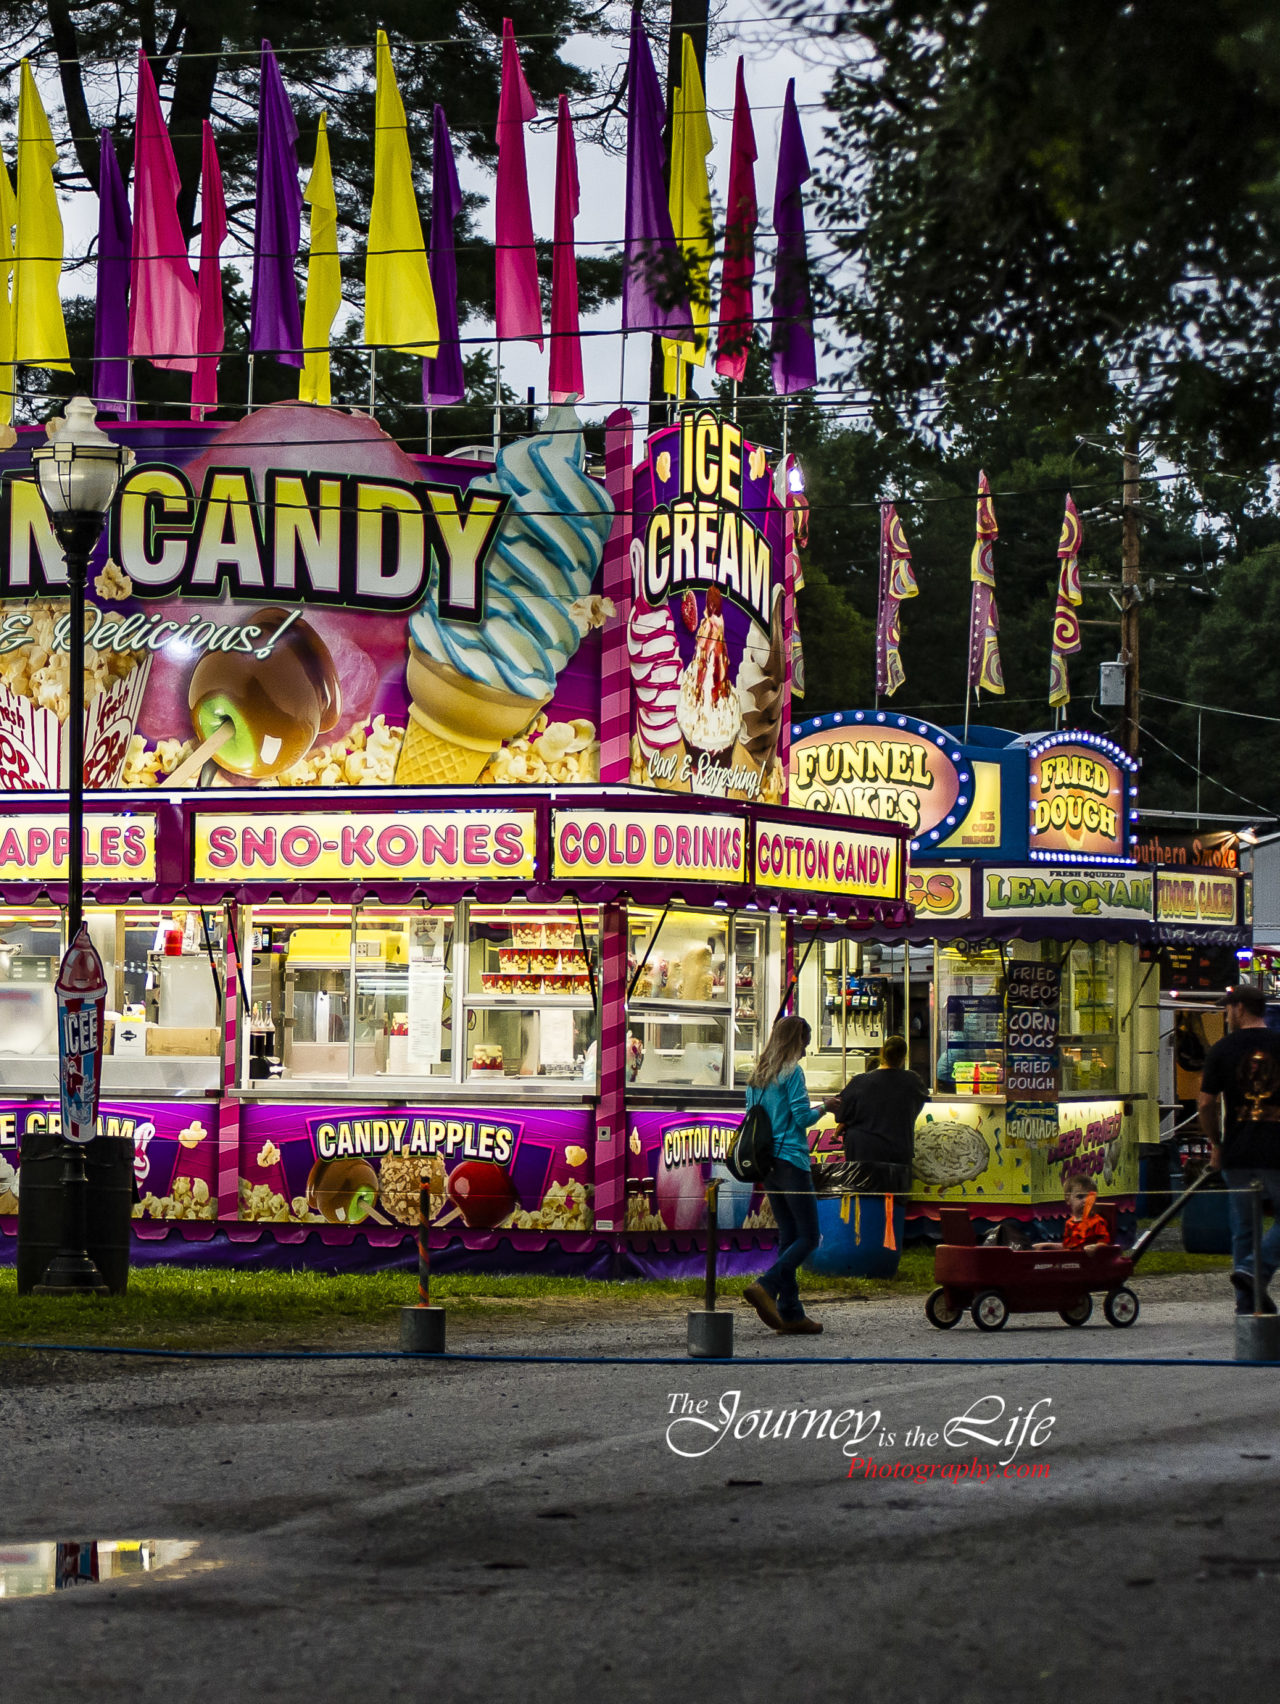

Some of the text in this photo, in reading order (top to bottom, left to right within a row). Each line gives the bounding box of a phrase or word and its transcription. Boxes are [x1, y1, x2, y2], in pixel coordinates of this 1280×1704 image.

[682, 411, 742, 508] ICE
[119, 467, 506, 615] CANDY
[647, 500, 771, 625] CREAM
[96, 688, 130, 736] fresh
[82, 729, 121, 786] POP
[647, 749, 767, 800] Cool & Refreshing!
[796, 740, 934, 790] FUNNEL
[1040, 754, 1111, 798] FRIED
[1035, 795, 1118, 841] DOUGH
[207, 823, 526, 868] SNO-KONES
[559, 822, 742, 871] COLD DRINKS
[757, 832, 891, 886] COTTON CANDY
[1130, 835, 1238, 869] outhern Smoke
[1049, 870, 1126, 879] FRESH SQUEEZED
[1008, 983, 1060, 999] OREOS
[1012, 966, 1056, 982] FRIED
[62, 1008, 98, 1058] ICEE
[1009, 1011, 1056, 1032] CORN
[1009, 1033, 1055, 1048] DOGS
[1008, 1077, 1055, 1090] DOUGH
[1014, 1061, 1051, 1074] FRIED
[317, 1119, 515, 1166] CANDY APPLES
[664, 1126, 710, 1171] COTTON
[1006, 1117, 1059, 1140] LEMONADE
